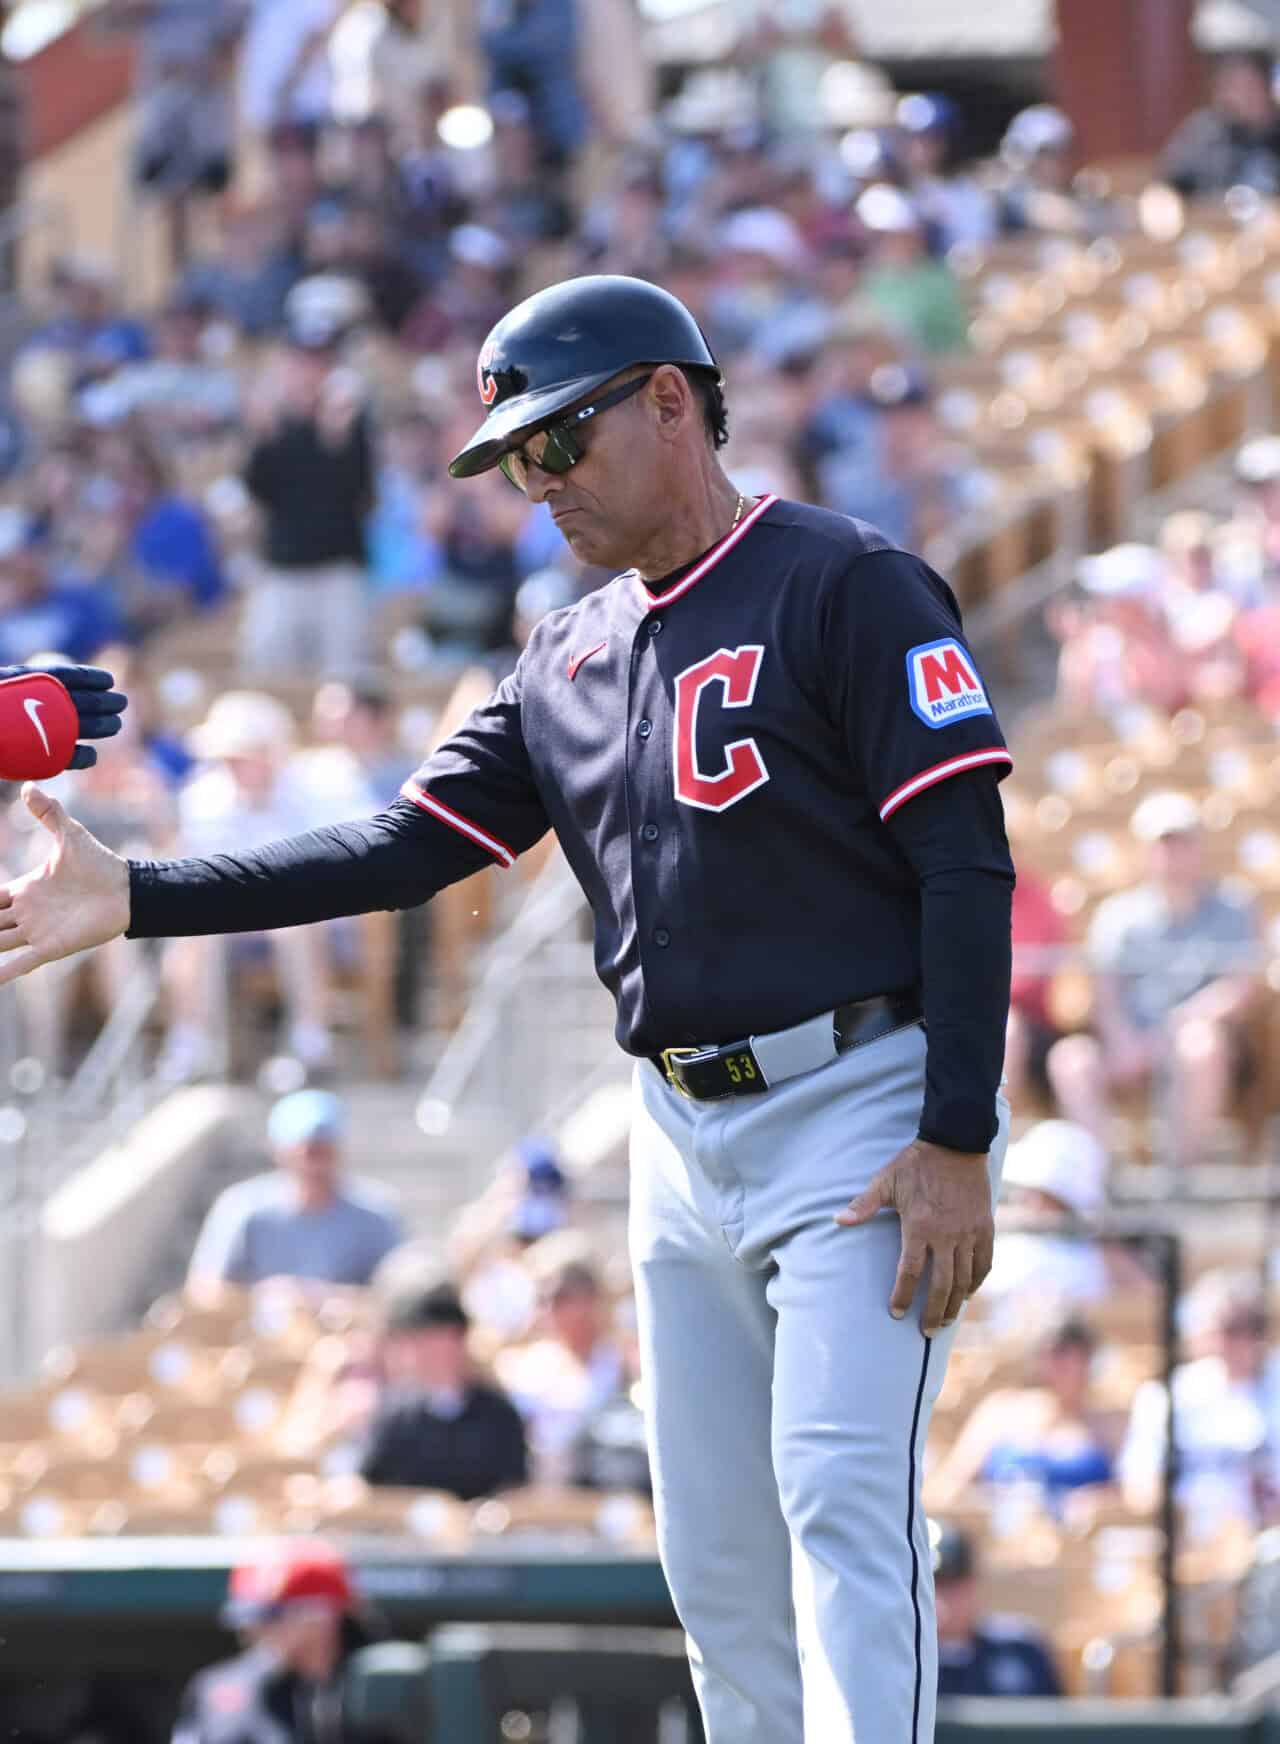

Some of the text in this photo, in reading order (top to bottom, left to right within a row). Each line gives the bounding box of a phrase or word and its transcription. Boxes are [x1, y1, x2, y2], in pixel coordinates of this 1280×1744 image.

[920, 649, 978, 703] M
[673, 645, 770, 812] C
[725, 1054, 756, 1083] 53
